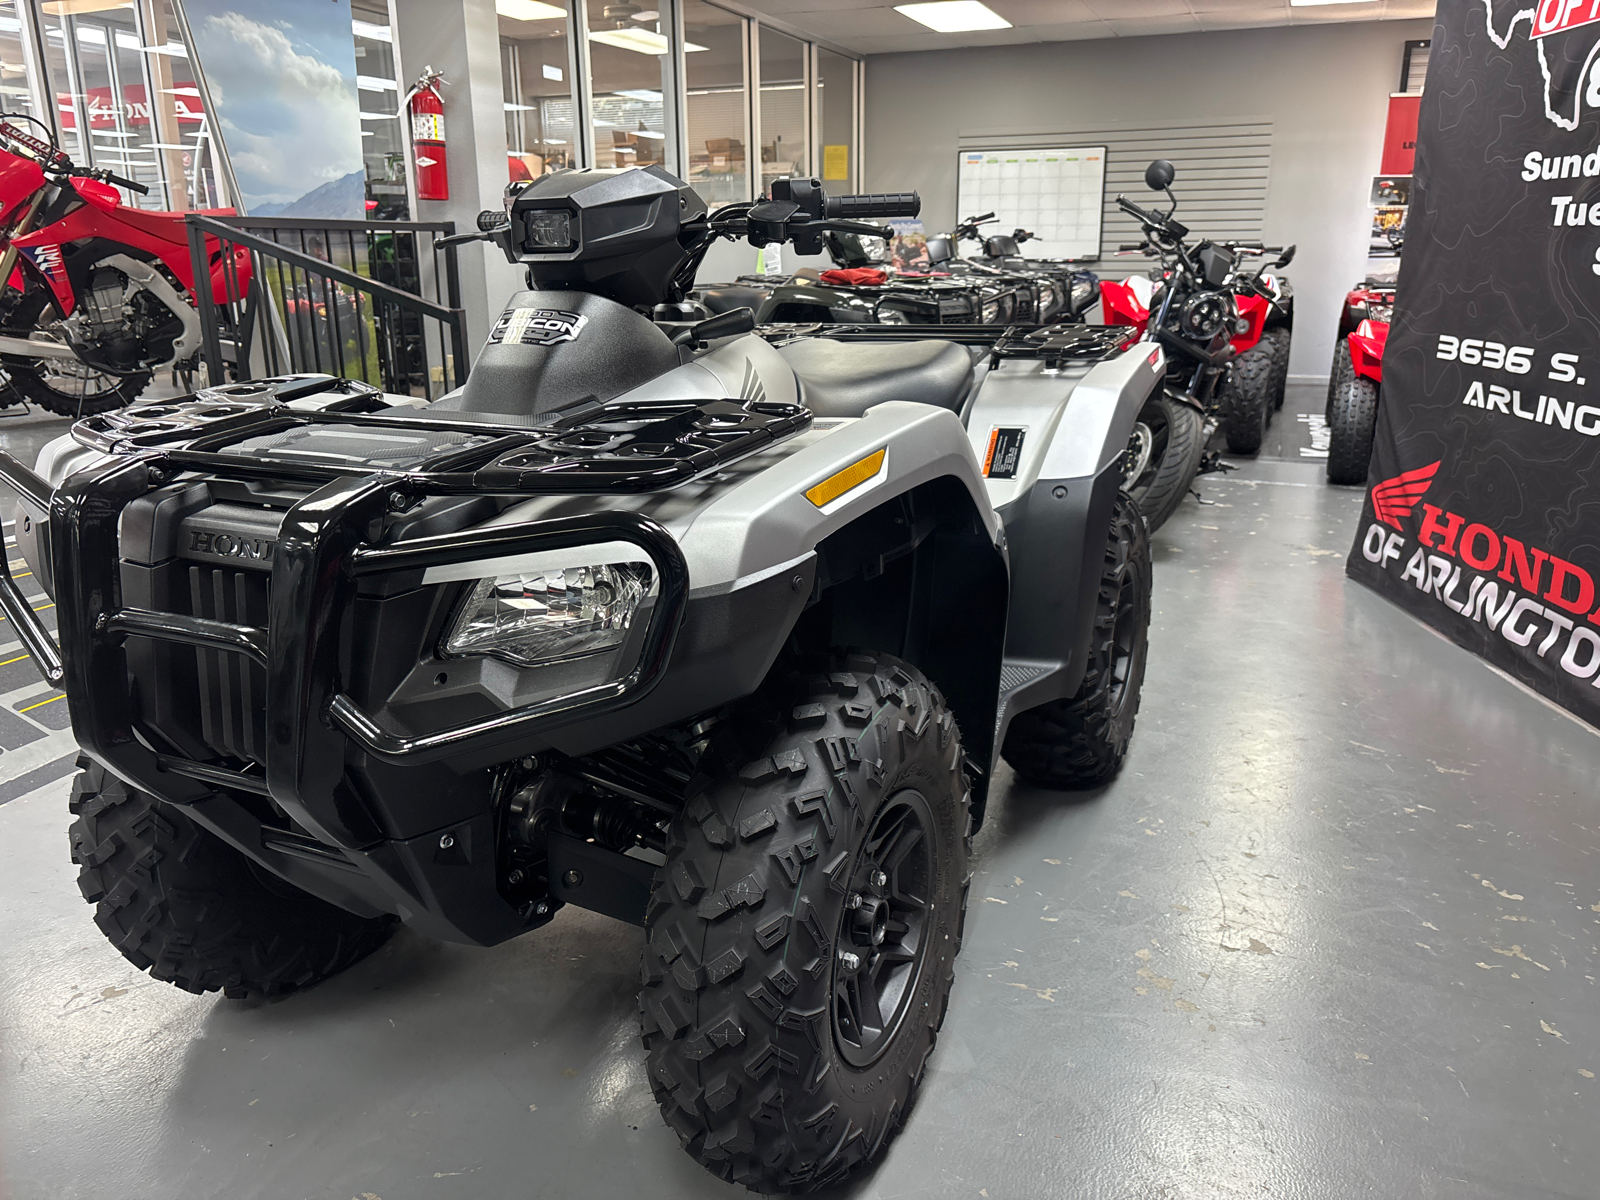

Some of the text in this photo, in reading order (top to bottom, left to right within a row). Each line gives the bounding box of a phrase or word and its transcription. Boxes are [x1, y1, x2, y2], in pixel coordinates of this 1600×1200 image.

[1521, 145, 1600, 182] Sund
[1551, 195, 1600, 227] Tue
[33, 243, 62, 271] CRF
[1436, 334, 1586, 386] 3636 S.
[189, 531, 275, 561] HON
[1417, 503, 1600, 626] HOND
[1362, 523, 1600, 689] OF ARLINGTO
